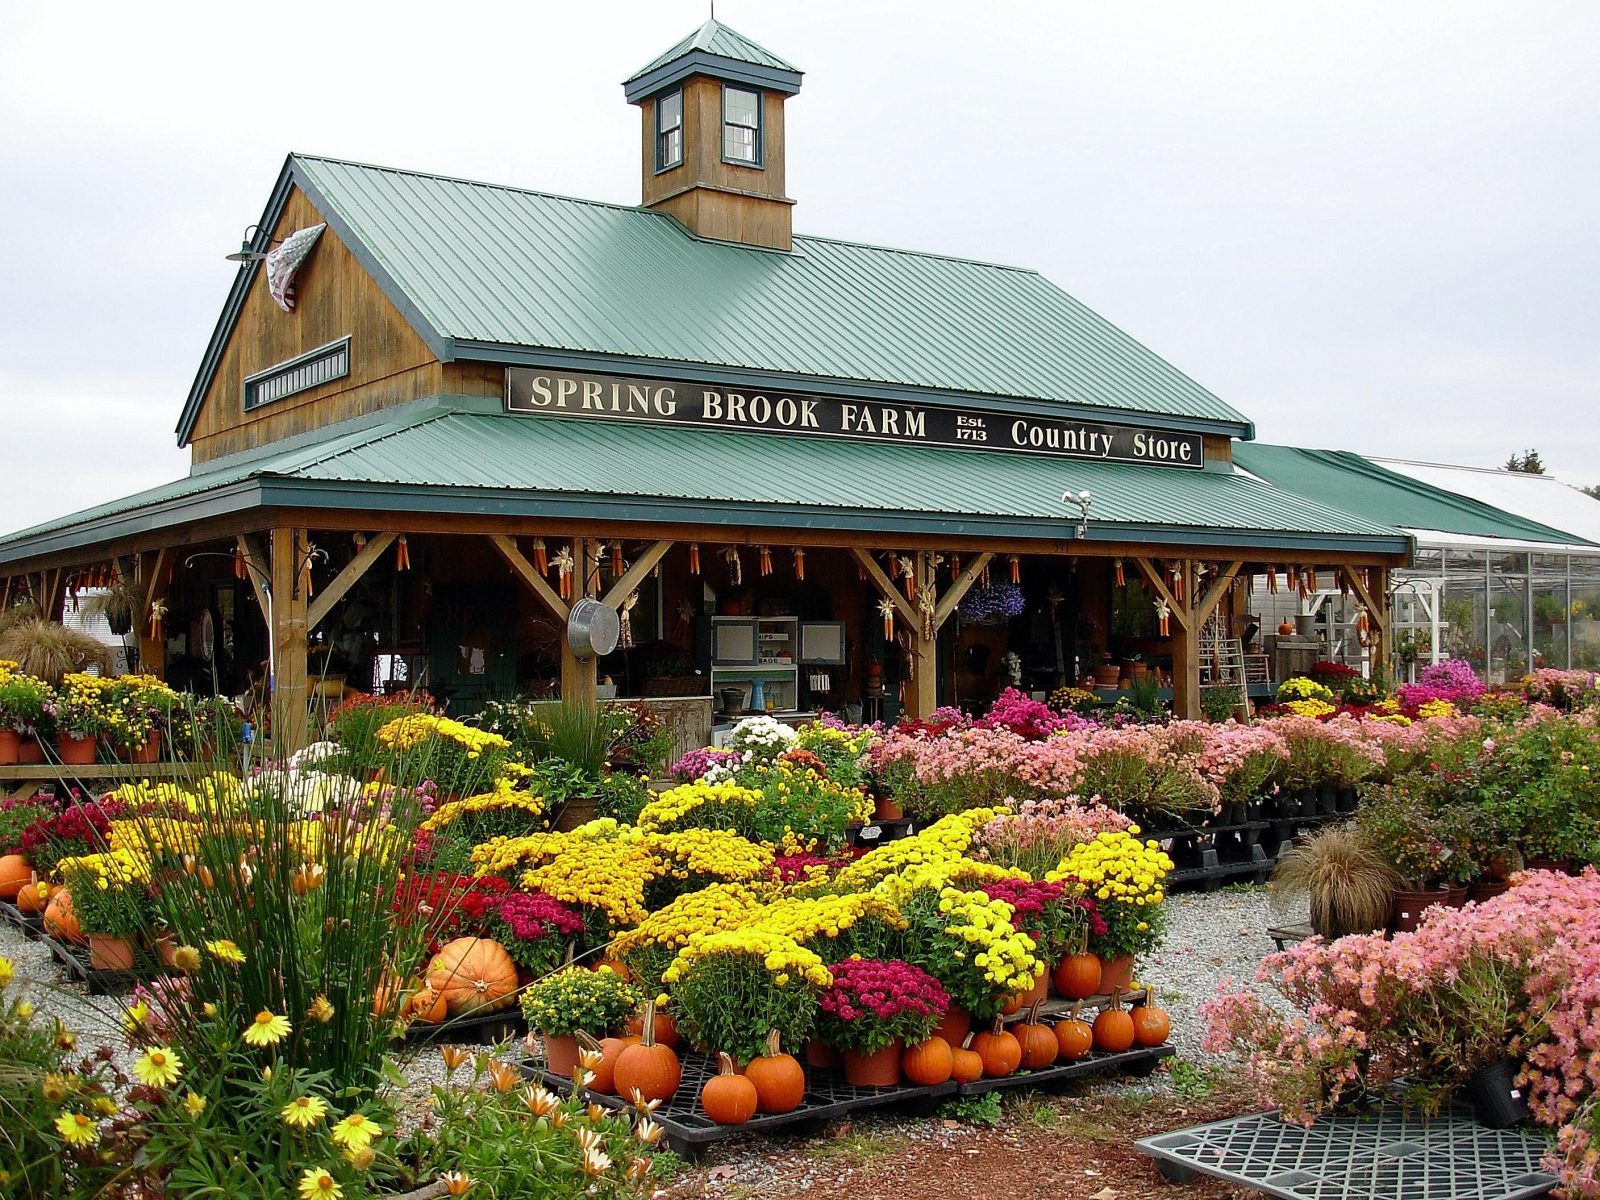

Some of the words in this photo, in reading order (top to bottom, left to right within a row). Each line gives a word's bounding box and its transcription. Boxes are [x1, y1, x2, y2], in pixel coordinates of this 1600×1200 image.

[530, 376, 677, 416] SPRING
[701, 391, 820, 428] BROOK
[840, 404, 926, 437] FARM
[956, 415, 986, 428] Est.
[956, 428, 988, 441] 1713
[1011, 420, 1113, 457] Country
[1133, 433, 1191, 461] Store
